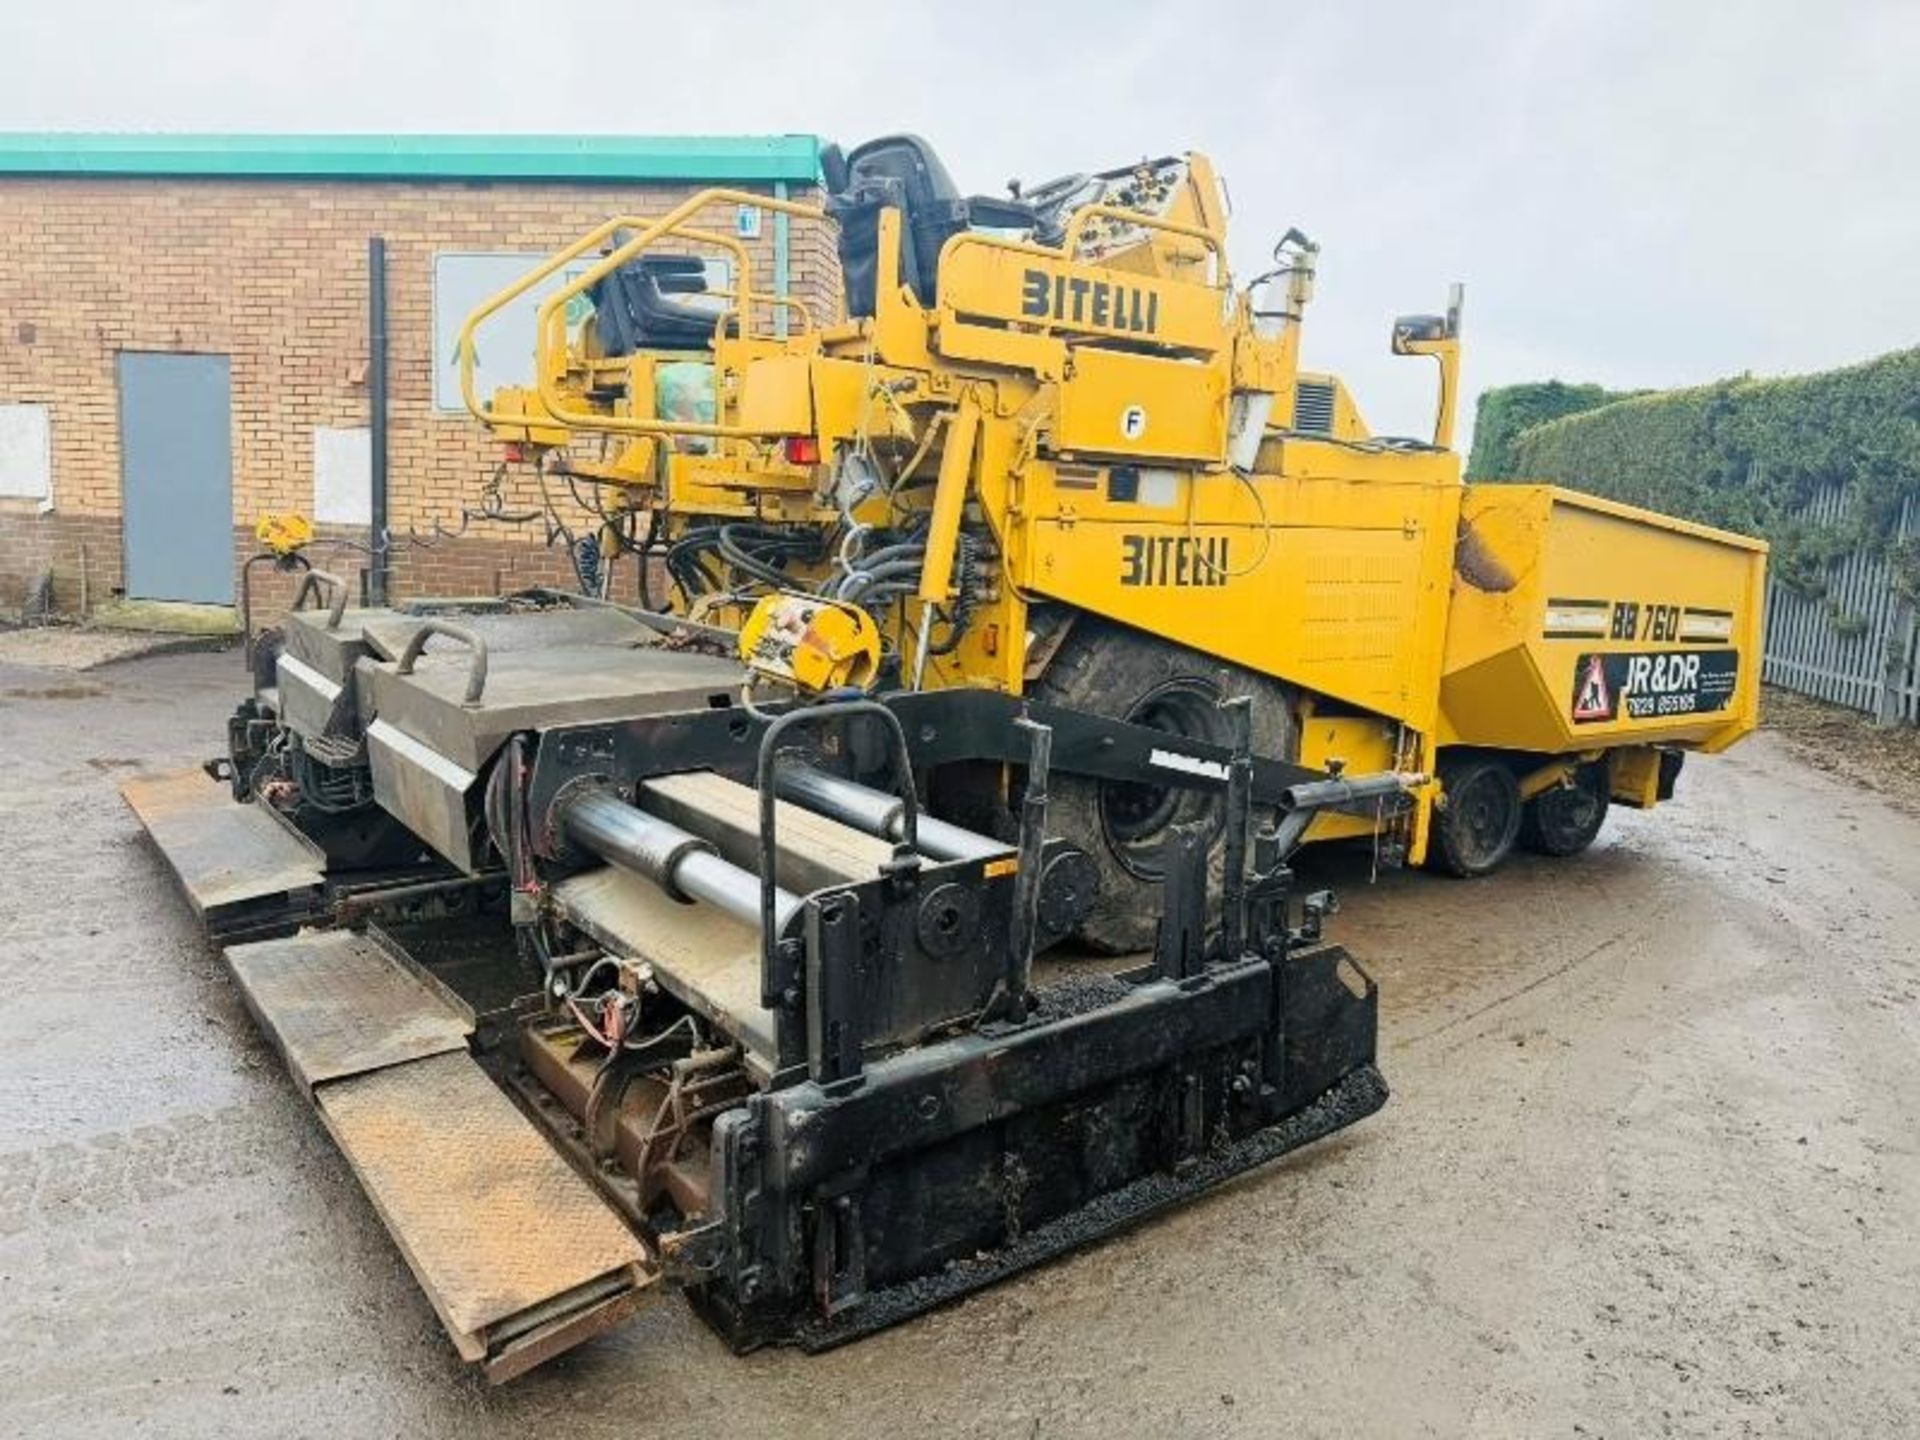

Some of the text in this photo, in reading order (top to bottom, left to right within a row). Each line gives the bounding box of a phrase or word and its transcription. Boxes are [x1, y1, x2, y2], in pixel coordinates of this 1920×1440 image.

[1022, 268, 1158, 334] BITELLI
[1127, 411, 1141, 433] F
[1120, 534, 1229, 587] BITELLI
[1610, 601, 1680, 642] BB 760
[1619, 653, 1700, 695] JR&DR
